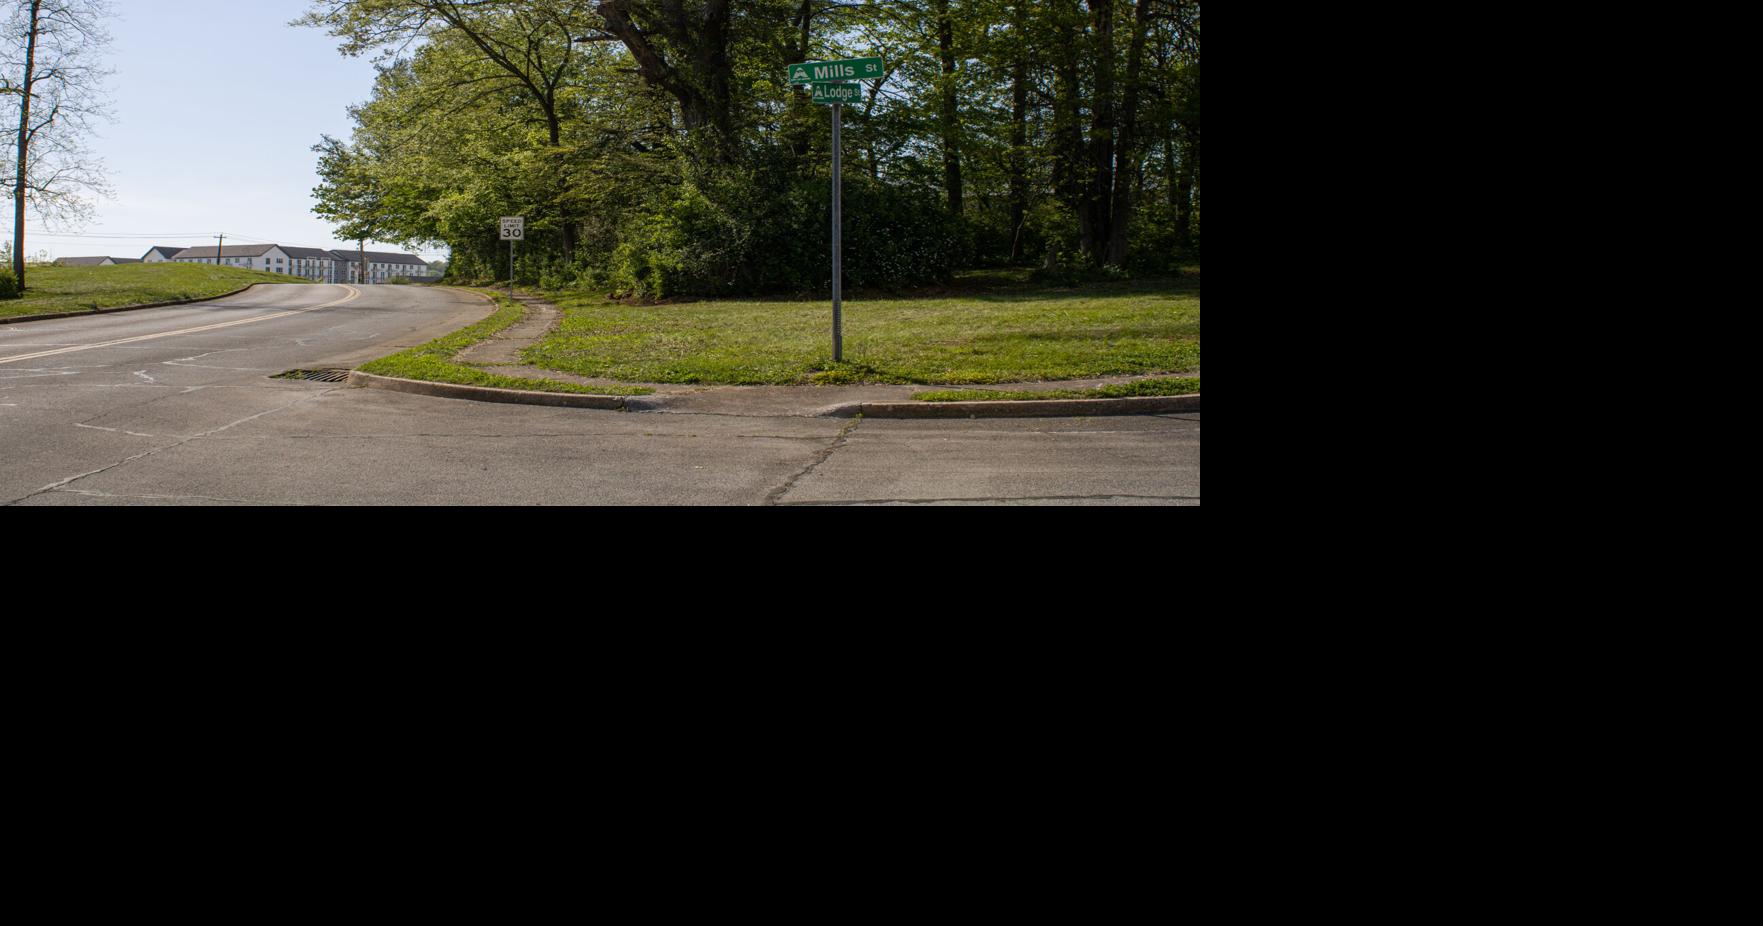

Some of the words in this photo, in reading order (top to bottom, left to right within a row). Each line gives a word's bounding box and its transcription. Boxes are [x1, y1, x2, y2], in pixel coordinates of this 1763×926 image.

[814, 64, 855, 79] Mills
[865, 63, 878, 72] St
[824, 84, 852, 101] Lodge
[503, 228, 521, 237] 30
